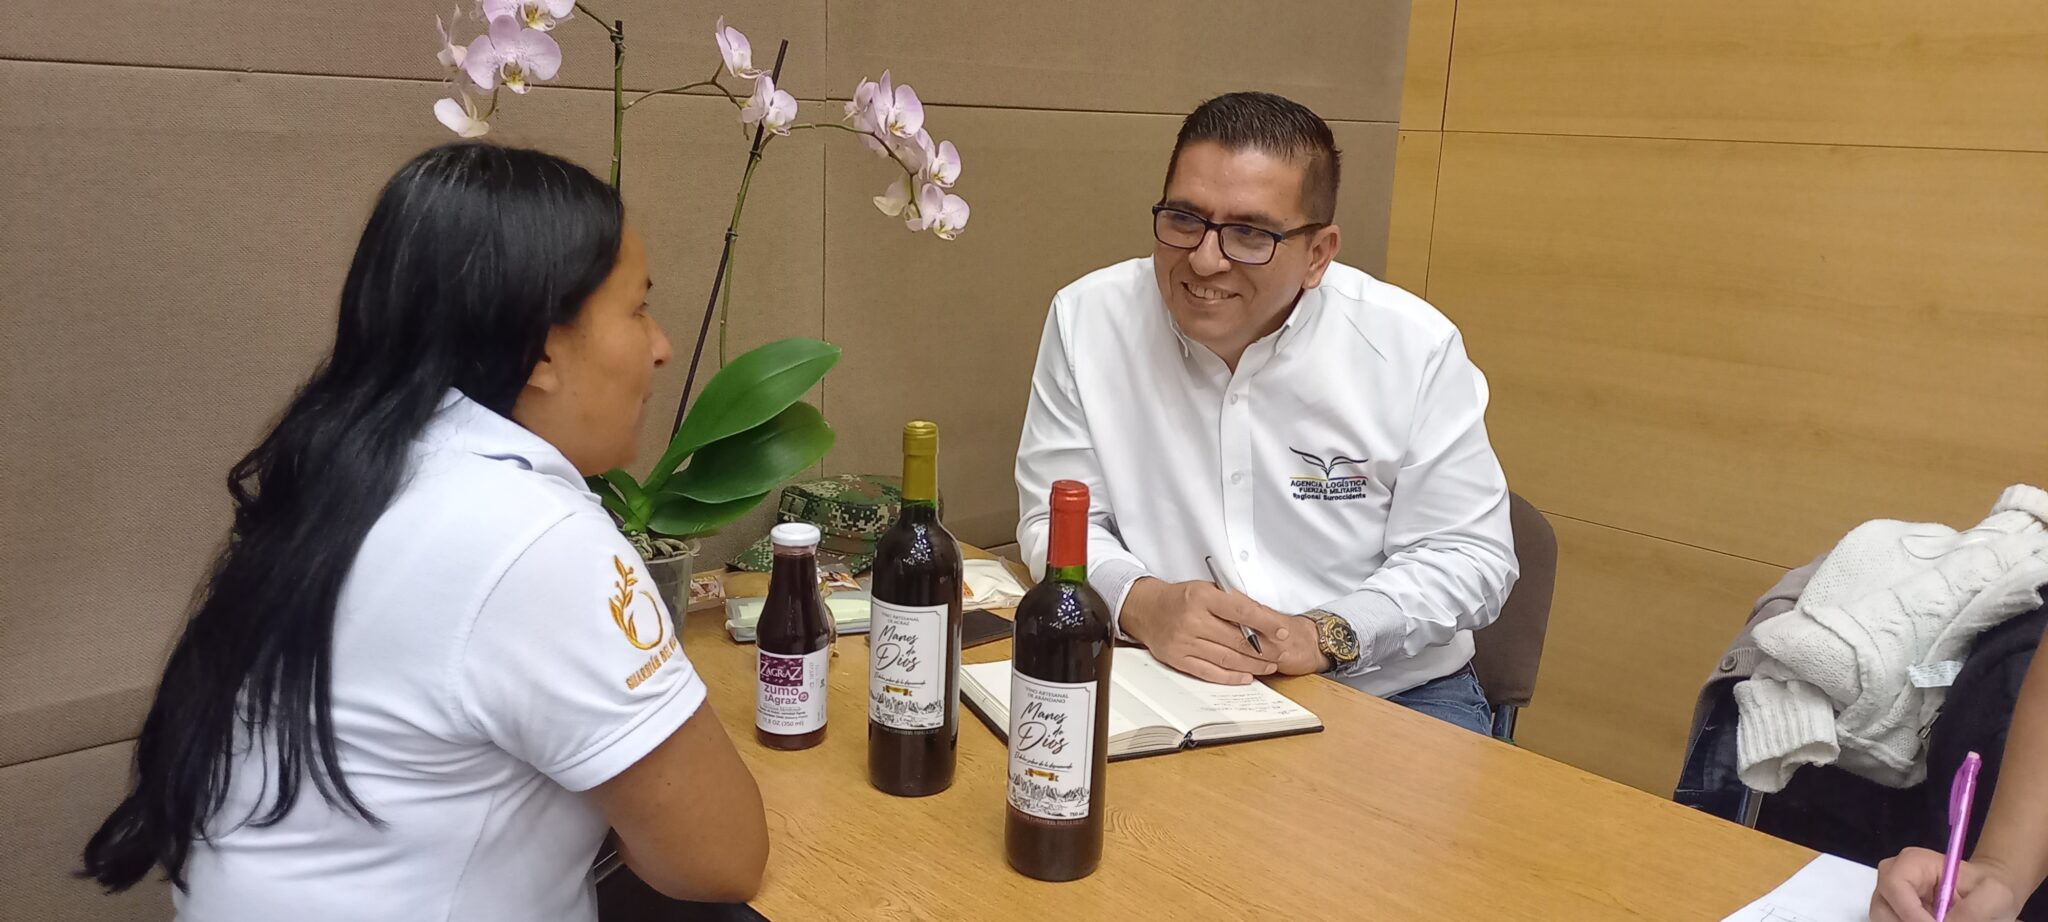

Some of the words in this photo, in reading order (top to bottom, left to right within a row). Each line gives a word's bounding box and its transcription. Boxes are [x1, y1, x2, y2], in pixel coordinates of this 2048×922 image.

[1290, 480, 1323, 488] AGENCIA
[1326, 479, 1367, 488] LOGÍSTICA
[1293, 493, 1321, 501] Regional
[1323, 493, 1366, 501] Suroccidente
[878, 624, 918, 644] Manos
[875, 643, 921, 672] Dios
[764, 684, 799, 696] zumo
[1020, 701, 1068, 724] Manos
[1017, 721, 1069, 755] Dios
